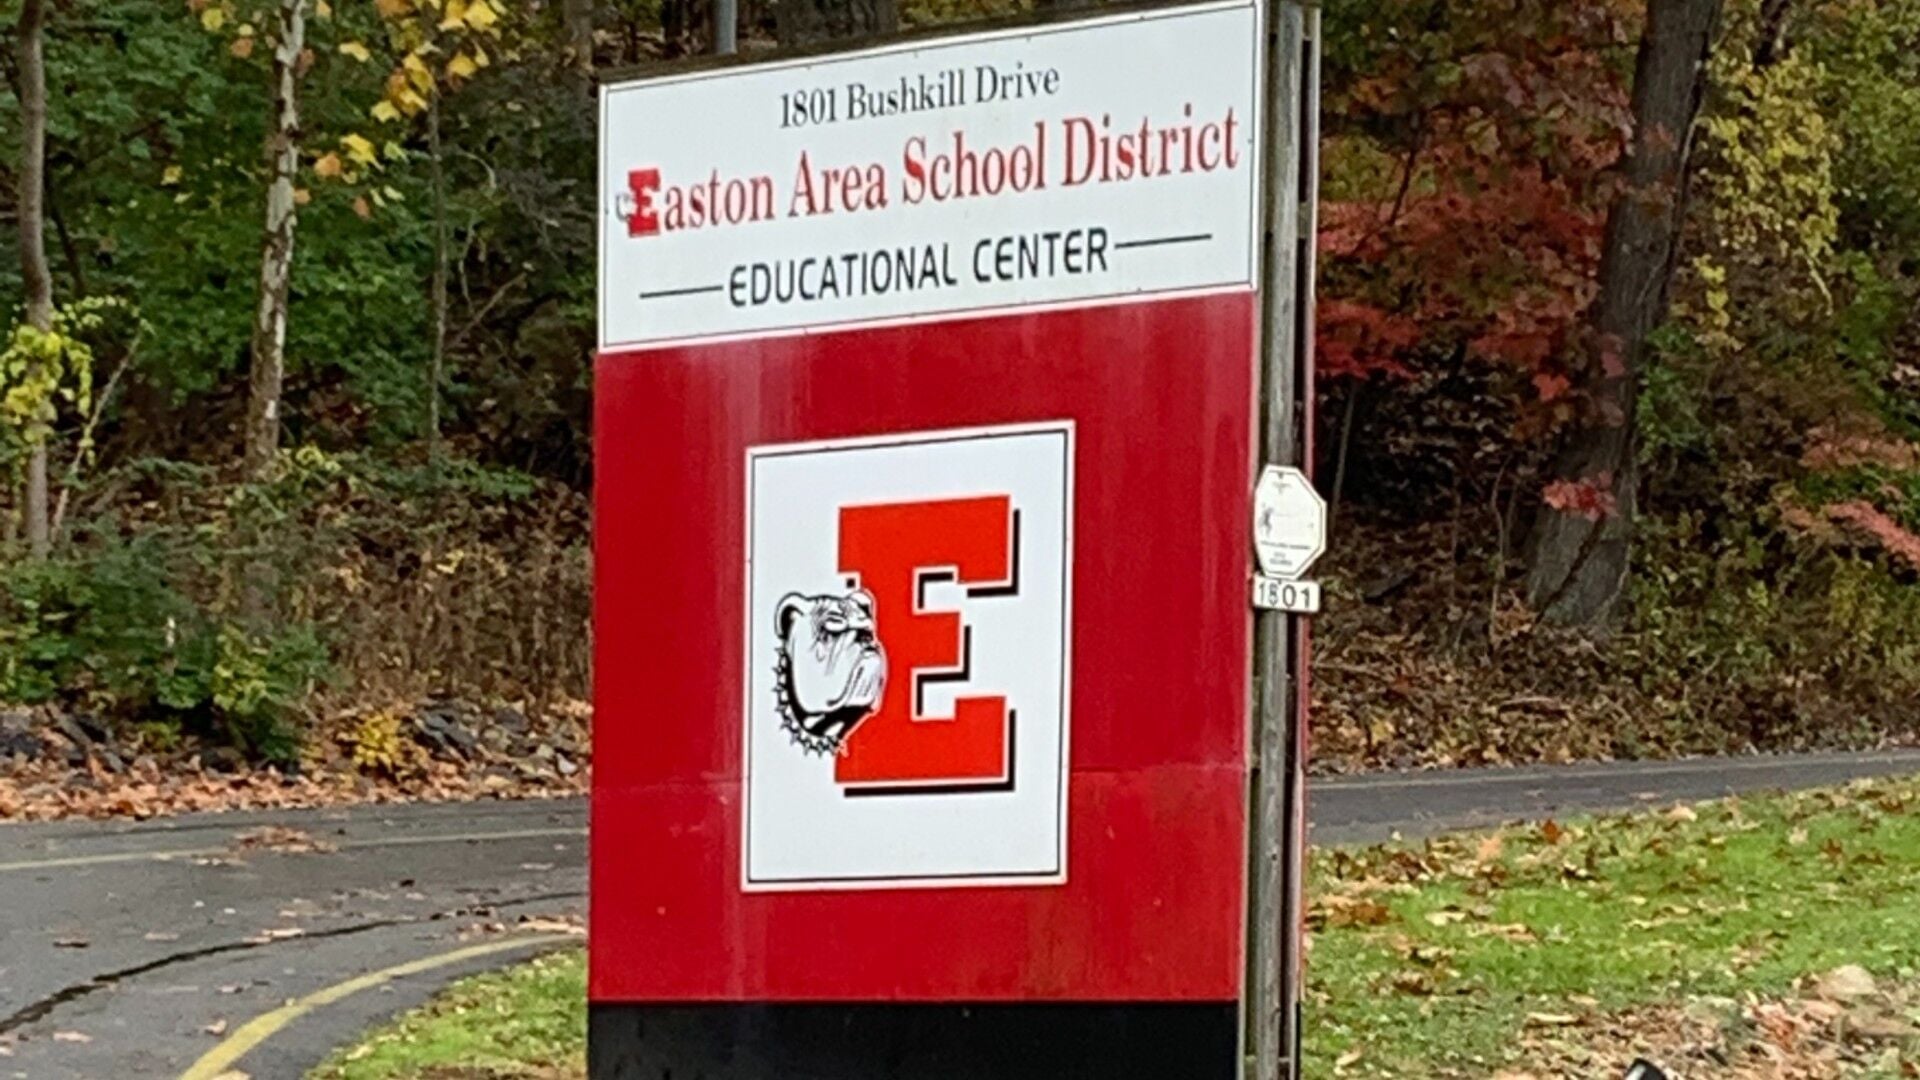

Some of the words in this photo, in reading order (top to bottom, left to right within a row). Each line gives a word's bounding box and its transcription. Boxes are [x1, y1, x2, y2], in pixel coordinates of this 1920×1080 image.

[780, 88, 838, 128] 1801
[847, 68, 965, 121] Bushkill
[975, 61, 1060, 103] Drive
[627, 168, 775, 238] Easton
[787, 150, 888, 217] Area
[903, 120, 1046, 205] School
[1061, 102, 1239, 187] District
[729, 242, 957, 307] EDUCATIONAL
[973, 227, 1108, 282] CENTER
